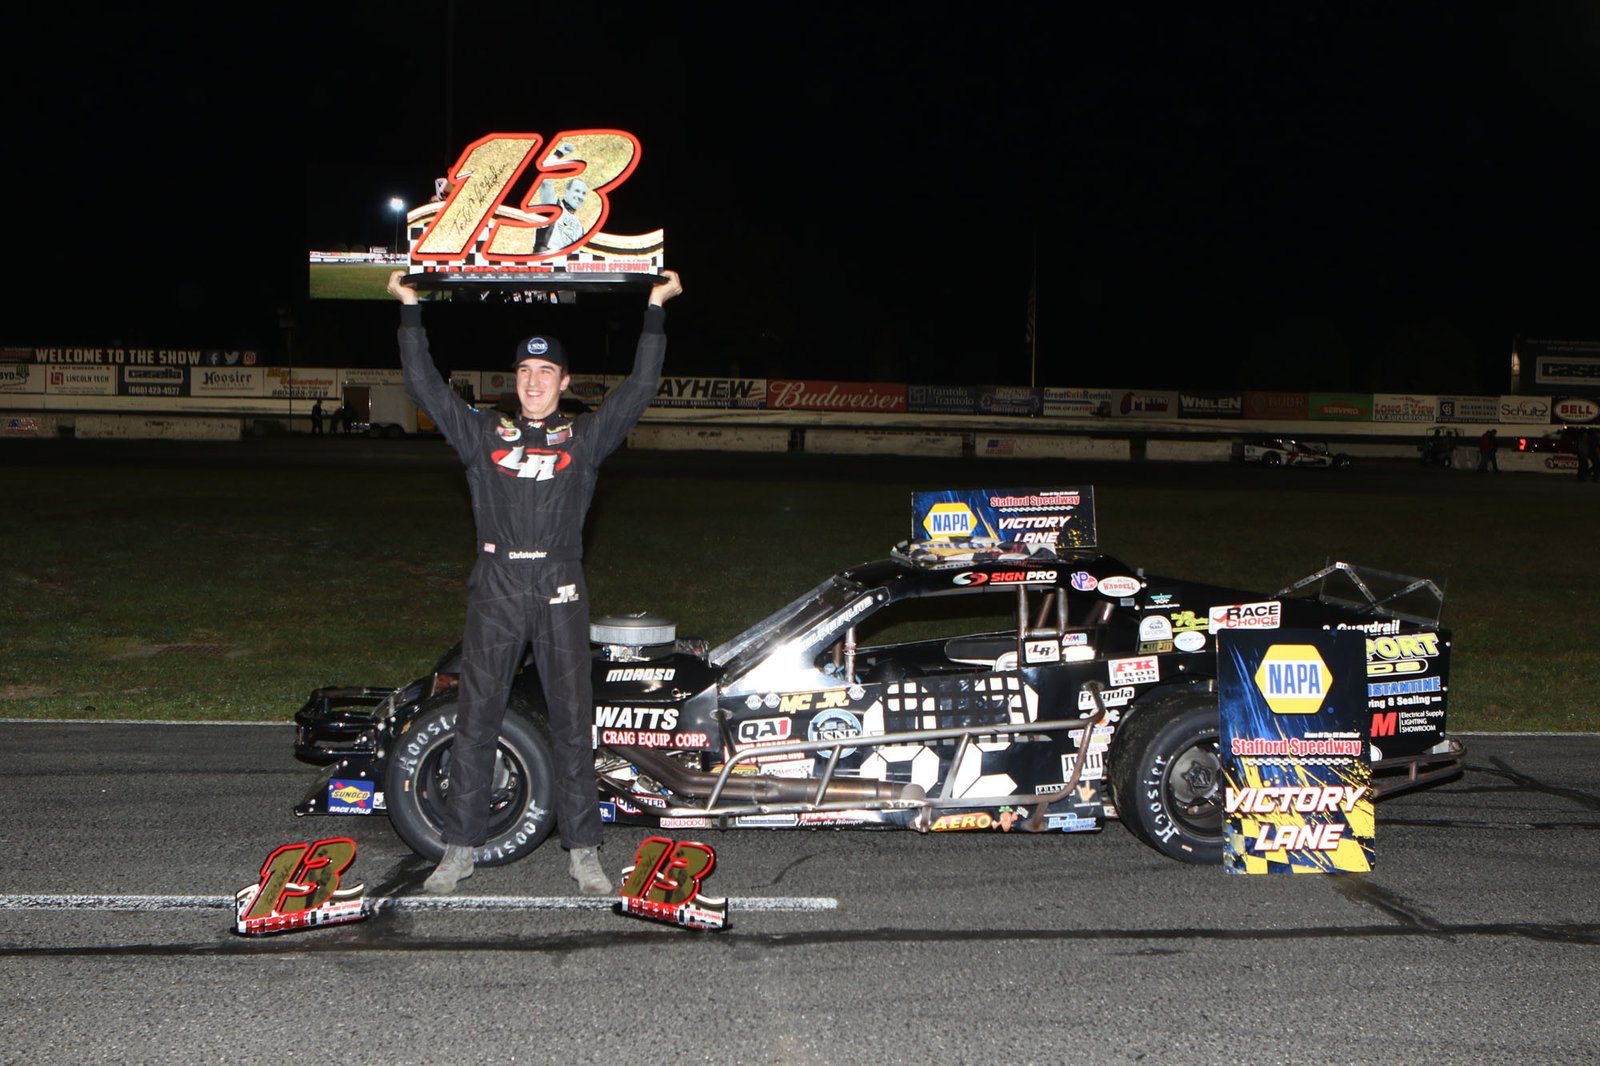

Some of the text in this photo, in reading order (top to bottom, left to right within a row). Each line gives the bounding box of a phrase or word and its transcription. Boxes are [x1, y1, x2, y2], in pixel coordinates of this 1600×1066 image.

[411, 128, 643, 263] 13
[566, 262, 651, 273] STAFFORD SPEEDWAY
[36, 348, 201, 365] WELCOME TO THE SHOW
[66, 374, 109, 383] LINCOLN TECH
[203, 370, 252, 385] Hoosier
[656, 379, 755, 398] AYHEW
[769, 382, 905, 409] Budweiser
[1180, 395, 1242, 409] WHELEN
[1560, 404, 1593, 415] BELL
[1501, 403, 1547, 418] Schultz
[991, 495, 1080, 507] Stafford Speedway
[933, 513, 968, 533] NAPA
[999, 515, 1072, 530] VICTORY
[1014, 533, 1059, 544] LANE
[508, 551, 547, 560] Christopher
[990, 571, 1058, 581] SIGN PRO
[1071, 572, 1090, 590] VP
[1226, 605, 1280, 620] RACE
[1225, 616, 1280, 629] CHOICE
[606, 668, 676, 682] MOROSO
[1113, 676, 1157, 685] ENDS
[1269, 663, 1322, 694] NAPA
[1080, 689, 1134, 704] Frgola
[1397, 695, 1431, 706] Sealing
[595, 706, 680, 731] WATTS
[1401, 709, 1445, 721] Electrical Supply
[1401, 717, 1428, 727] LIGHTING
[741, 719, 789, 740] QA1
[1370, 711, 1398, 737] M
[1401, 724, 1437, 734] SHOWROOM
[602, 731, 710, 748] CRAIG EQUIP. CORP.
[1231, 737, 1362, 756] Stafford Speedway
[333, 790, 369, 799] SUNOCO
[1225, 786, 1368, 814] VICTORY
[931, 813, 992, 830] AERO
[1254, 823, 1346, 851] LANE
[620, 836, 715, 906] 13
[242, 837, 357, 921] 13
